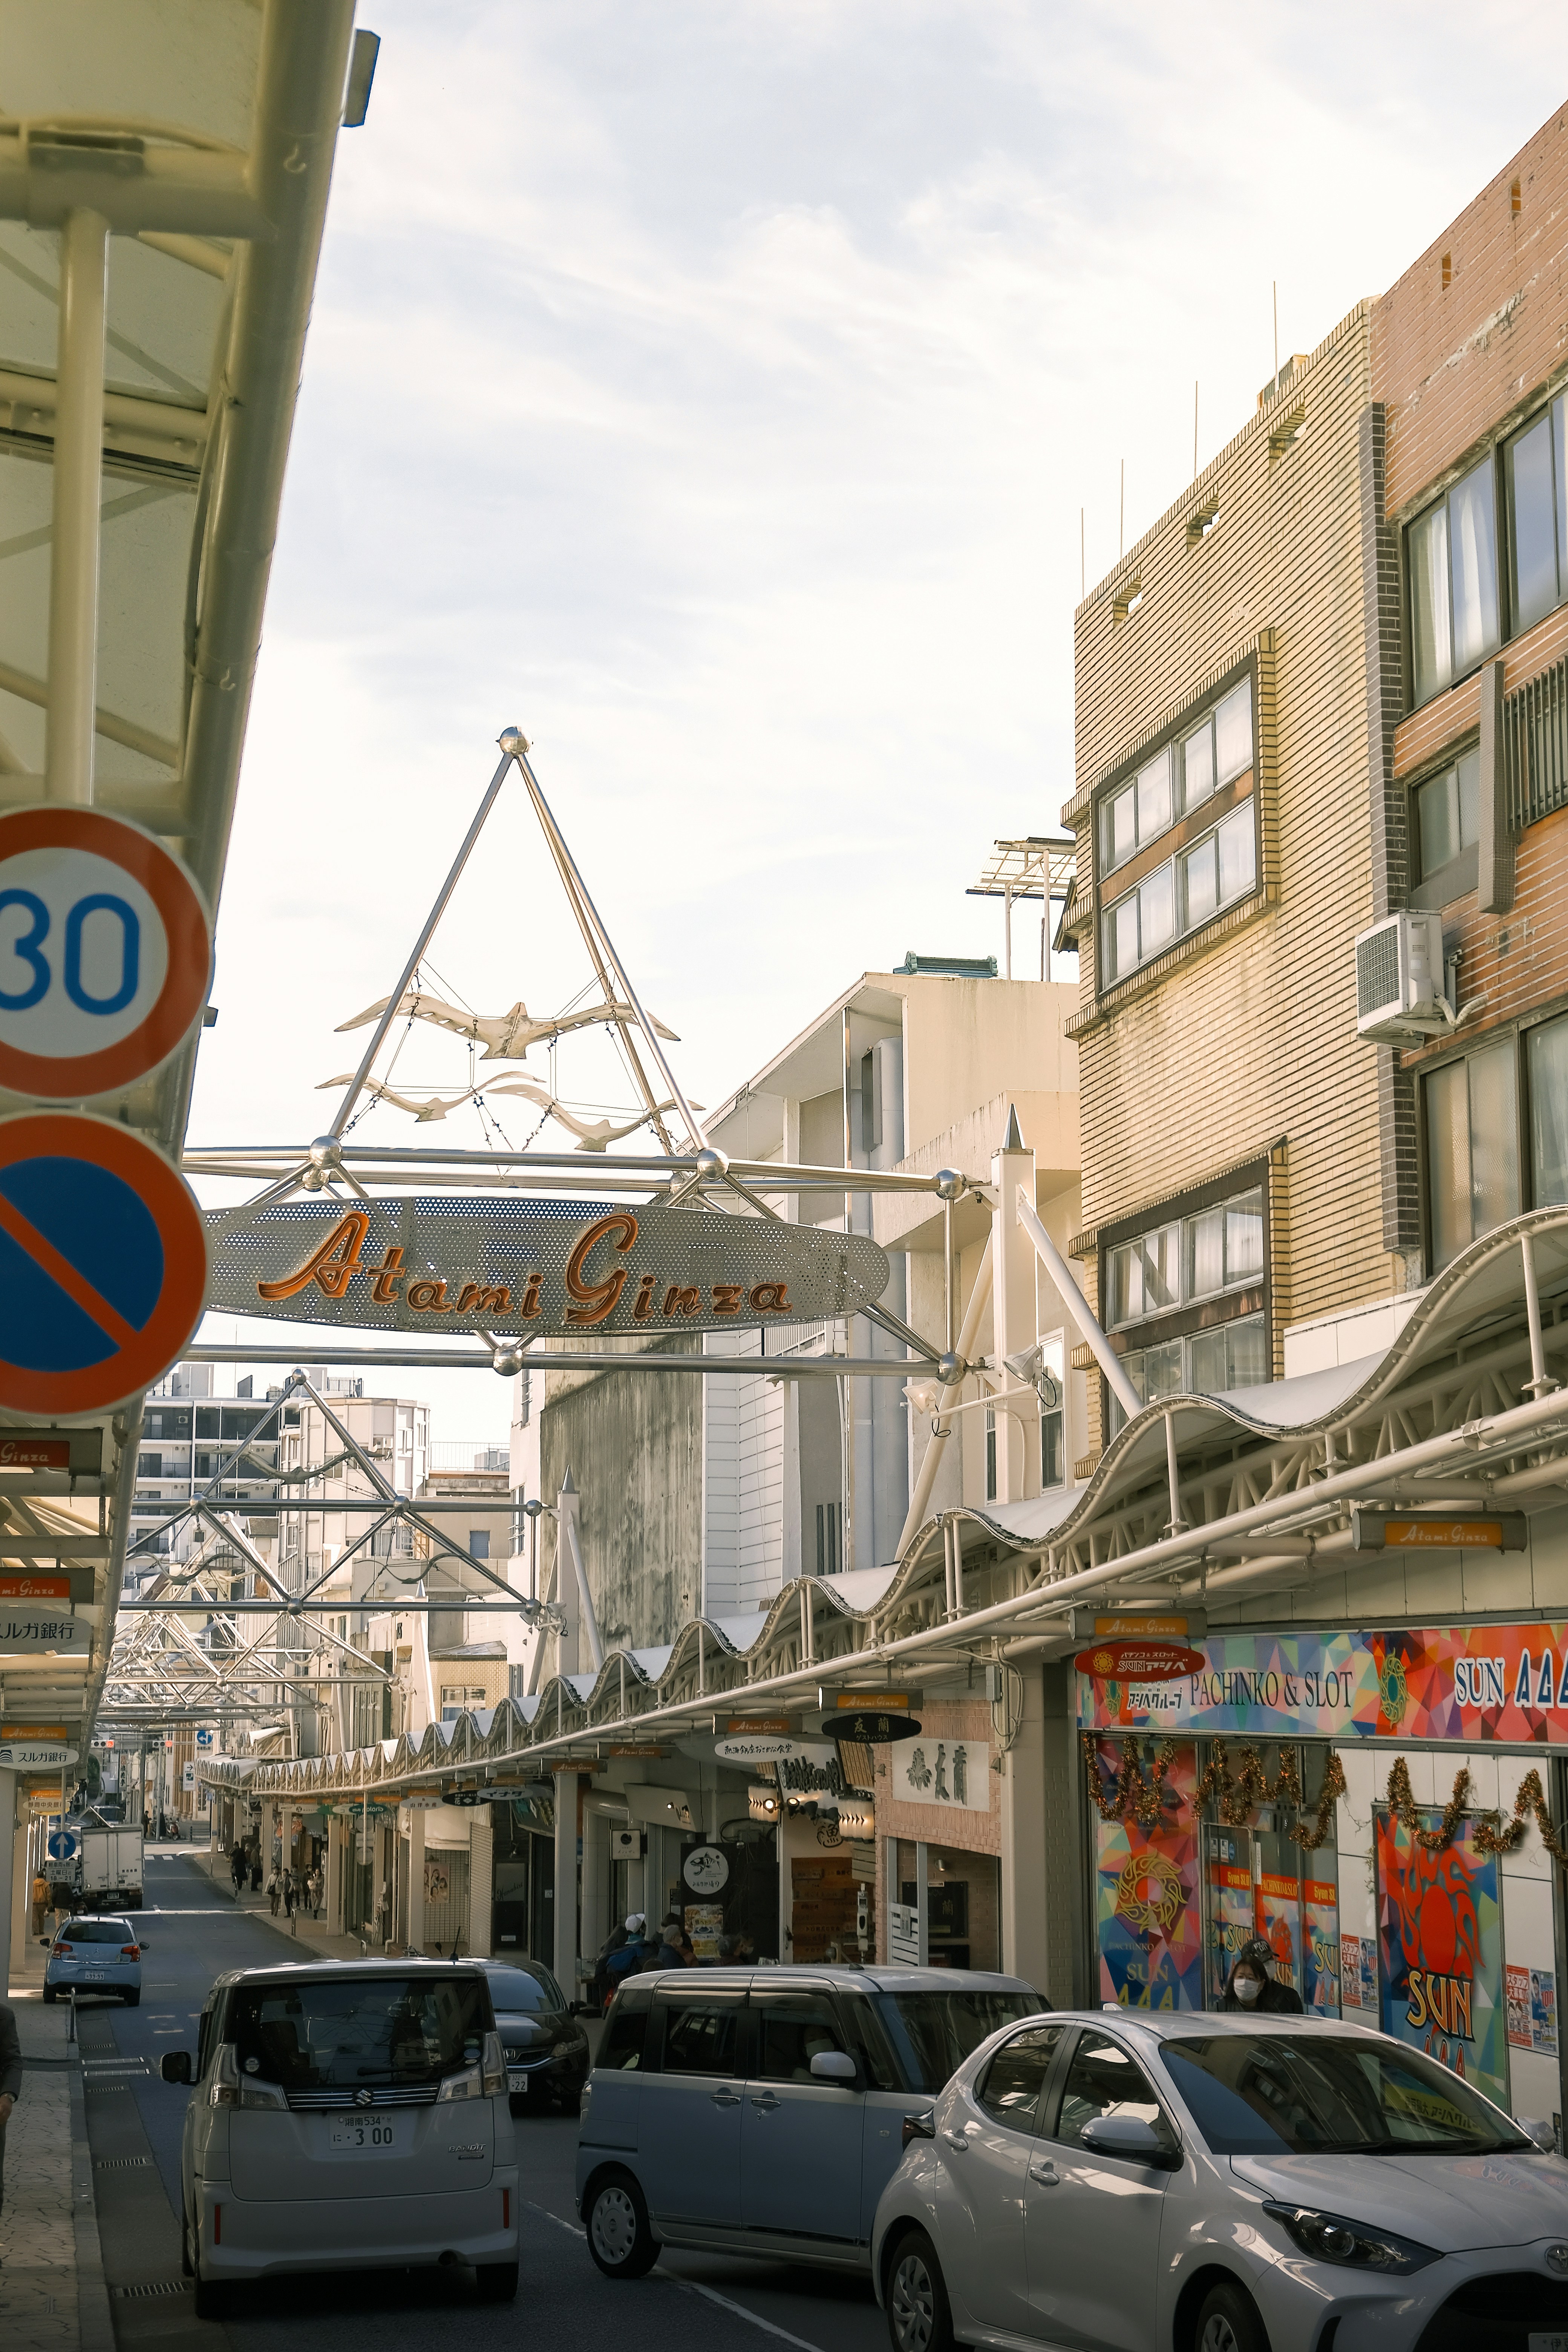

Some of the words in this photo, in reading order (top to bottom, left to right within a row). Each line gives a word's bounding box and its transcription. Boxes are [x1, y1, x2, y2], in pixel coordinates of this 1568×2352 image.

[0, 889, 140, 1015] 30
[257, 1211, 544, 1319] Atami
[564, 1213, 793, 1326] Ginza
[0, 1442, 49, 1463] Ginza
[1400, 1525, 1448, 1542] Atami
[1451, 1525, 1488, 1542] Ginza
[20, 1580, 54, 1596] Ginza
[1106, 1620, 1144, 1633] Atami
[1147, 1620, 1176, 1633] Ginza
[1190, 1671, 1279, 1707] PACHINKO
[1284, 1672, 1301, 1707] &
[1305, 1671, 1353, 1708] SLOT
[1455, 1658, 1505, 1707] SUN
[846, 1697, 874, 1706] Atami
[877, 1696, 899, 1706] Ginza
[9, 1728, 35, 1737] Atami
[38, 1728, 58, 1738] Ginza
[736, 1721, 761, 1730] Atami
[763, 1721, 782, 1730] Ginza
[18, 1753, 67, 1762] スルガ銀行
[1240, 1874, 1251, 1887] SLO
[1314, 1942, 1338, 1977] SU
[1127, 1963, 1168, 1981] SUN
[1508, 1974, 1528, 1988] スタッフ
[1406, 1971, 1474, 2039] SUN
[448, 2143, 486, 2153] BANDIT
